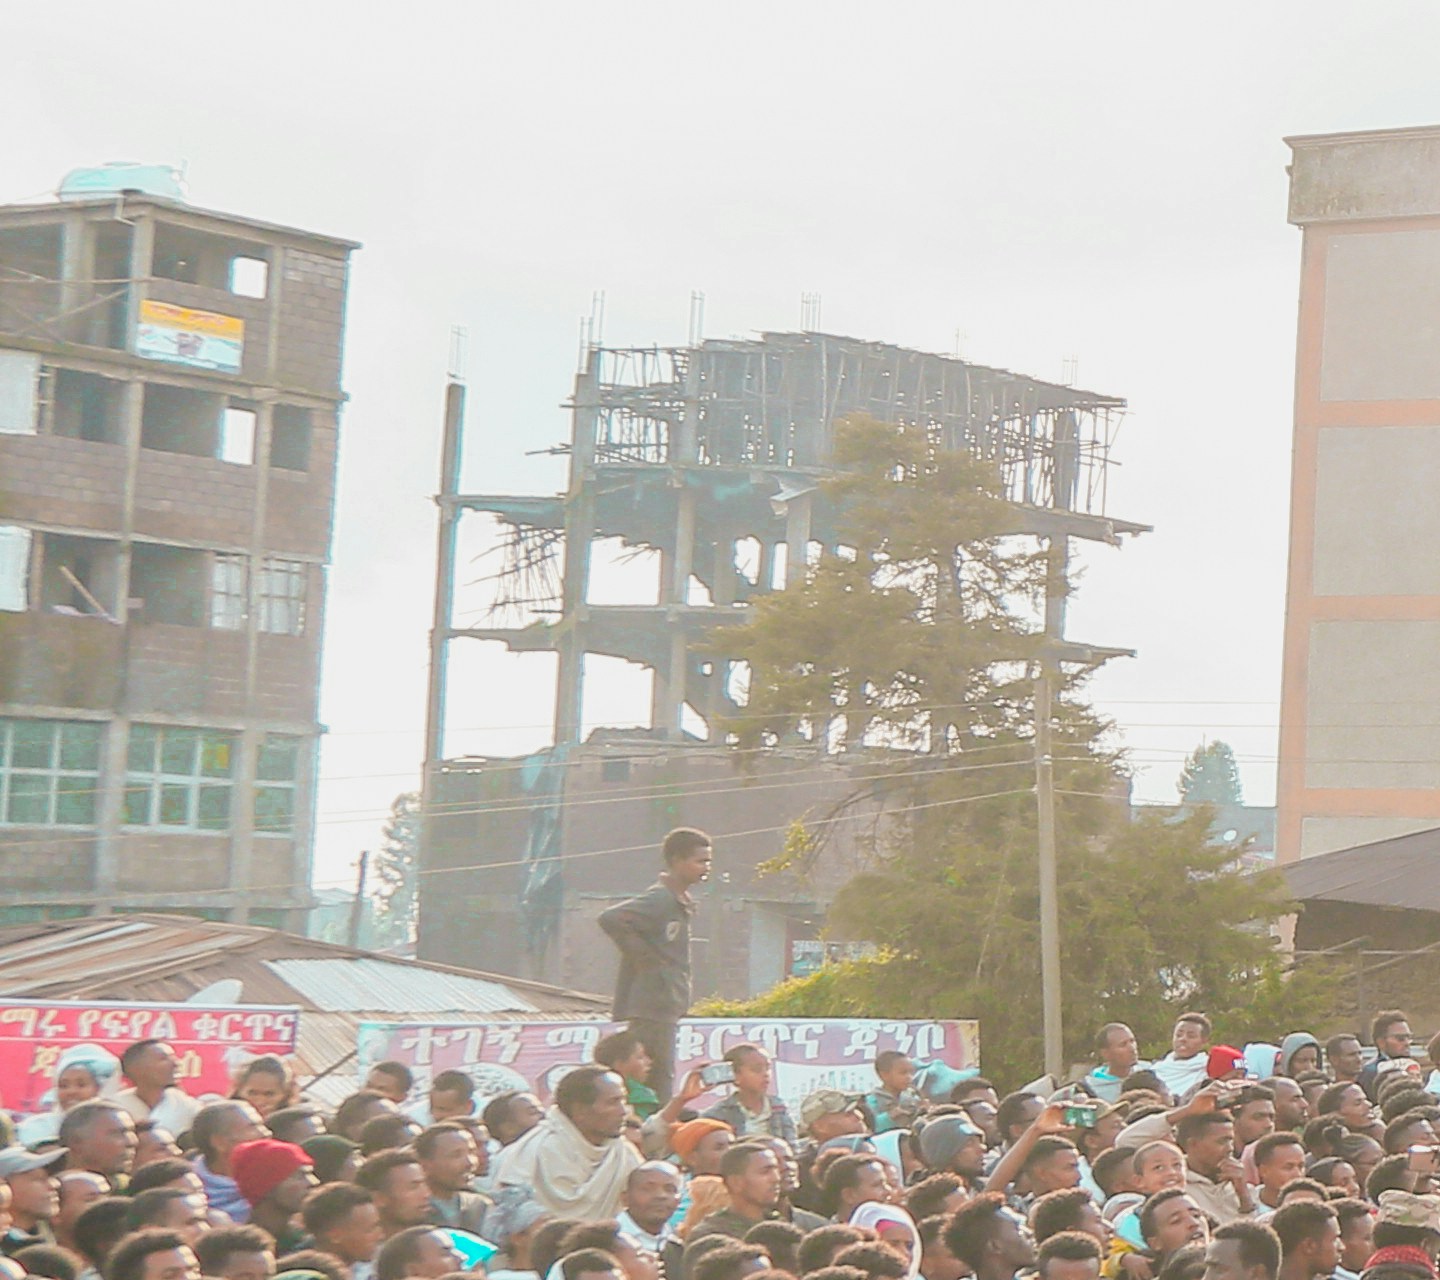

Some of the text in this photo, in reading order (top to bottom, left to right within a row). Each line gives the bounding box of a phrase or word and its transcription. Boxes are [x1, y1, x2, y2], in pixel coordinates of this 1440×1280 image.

[0, 1007, 295, 1043] ማሩ የፍየል ቁርጥና
[545, 1024, 629, 1063] ማ
